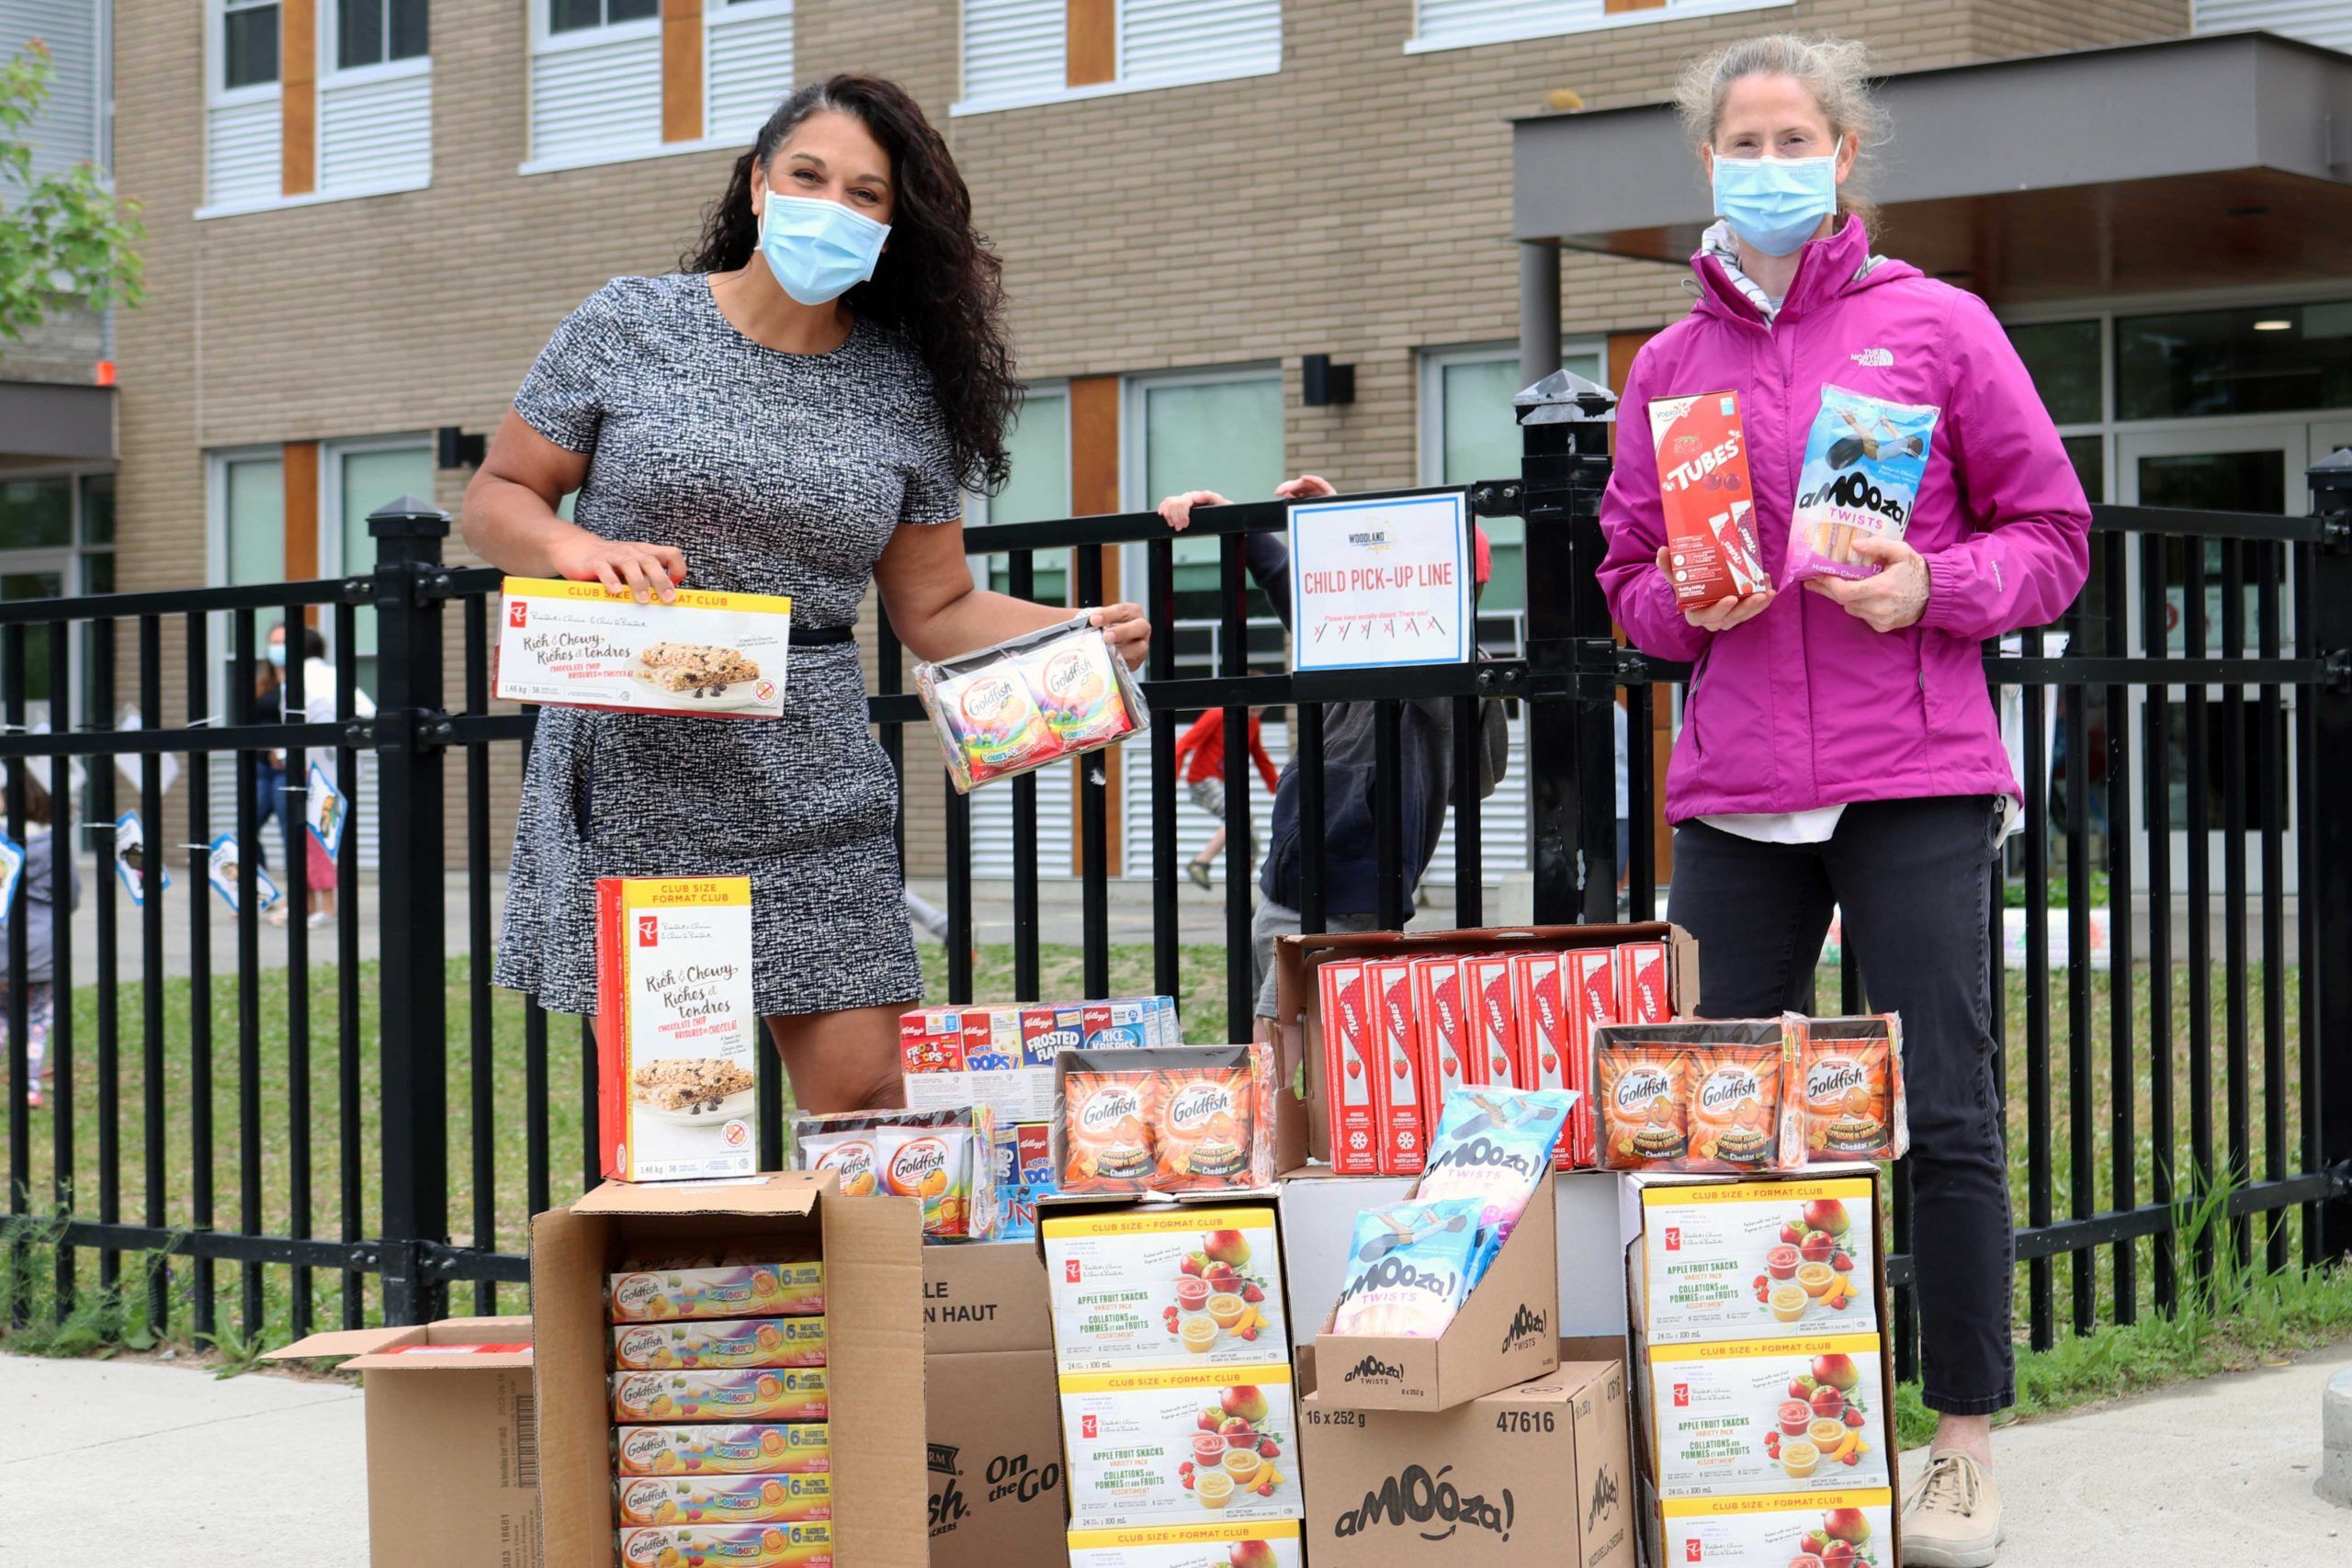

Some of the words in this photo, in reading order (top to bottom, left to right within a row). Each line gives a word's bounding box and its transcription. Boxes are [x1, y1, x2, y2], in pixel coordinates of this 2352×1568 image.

[1850, 354, 1880, 362] NORTH
[1666, 438, 1739, 491] TUBES
[1829, 507, 1883, 530] TWISTS
[1349, 532, 1385, 544] WOODLAND
[1872, 564, 1883, 574] 12
[1304, 570, 1346, 594] CHILD
[1351, 565, 1414, 592] PICK-UP
[1419, 563, 1453, 587] LINE
[568, 586, 600, 597] CLUB
[604, 590, 631, 600] SIZE
[696, 596, 728, 606] CLUB
[524, 633, 548, 651] Rich
[559, 632, 605, 649] Chewy
[537, 647, 573, 665] Riches
[584, 644, 631, 659] tendres
[1050, 655, 1093, 693] Goldfish
[968, 681, 1013, 716] Goldfish
[662, 885, 689, 893] CLUB
[693, 884, 717, 892] SIZE
[652, 895, 697, 904] FORMAT
[701, 893, 729, 903] CLUB
[646, 969, 676, 993] Rich
[687, 964, 739, 981] Chewy
[663, 986, 705, 1010] Riches
[1641, 984, 1658, 1017] TUBES
[679, 999, 731, 1020] tendres
[1084, 1012, 1110, 1022] Kellogg's
[1439, 1000, 1455, 1034] TUBES
[1487, 999, 1506, 1032] TUBES
[1538, 996, 1555, 1029] TUBES
[693, 1016, 707, 1026] CHIP
[1023, 1018, 1054, 1029] Kellogg's
[1343, 1002, 1360, 1036] TUBES
[1389, 1002, 1406, 1036] TUBES
[901, 1026, 925, 1036] Kellogg's
[963, 1027, 989, 1037] Kellogg's
[1102, 1031, 1125, 1042] RICE
[970, 1045, 992, 1055] CORN
[1027, 1031, 1080, 1054] FROSTED
[1808, 1067, 1863, 1098] Goldfish
[1618, 1078, 1668, 1108] Goldfish
[1703, 1080, 1757, 1109] Goldfish
[1084, 1098, 1137, 1126] Goldfish
[1174, 1092, 1228, 1122] Goldfish
[1020, 1139, 1046, 1149] Kellogg's
[1840, 1142, 1868, 1151] Cheddar
[1645, 1150, 1670, 1158] Cheddar
[1729, 1153, 1755, 1162] Cheddar
[896, 1151, 944, 1178] Goldfish
[1202, 1167, 1228, 1176] Cheddar
[1110, 1168, 1136, 1178] Cheddar
[1447, 1168, 1501, 1180] TWISTS
[1692, 1190, 1719, 1201] CLUB
[1721, 1190, 1744, 1199] SIZE
[1754, 1189, 1795, 1198] FORMAT
[1798, 1187, 1824, 1196] CLUB
[1091, 1223, 1118, 1232] CLUB
[1121, 1222, 1143, 1231] SIZE
[1154, 1220, 1193, 1229] FORMAT
[1197, 1218, 1224, 1227] CLUB
[1668, 1264, 1689, 1275] APPLE
[1689, 1262, 1710, 1273] FRUIT
[1711, 1260, 1739, 1271] SNACKS
[782, 1269, 793, 1286] 6
[619, 1282, 659, 1303] Goldfish
[1678, 1282, 1719, 1295] COLLATIONS
[1078, 1295, 1098, 1305] APPLE
[1099, 1293, 1119, 1303] FRUIT
[1121, 1292, 1148, 1302] SNACKS
[1362, 1292, 1419, 1305] TWISTS
[1669, 1292, 1700, 1304] POMMES
[1715, 1290, 1739, 1301] FRUITS
[943, 1304, 998, 1323] HAUT
[1088, 1314, 1129, 1325] COLLATIONS
[786, 1324, 797, 1340] 6
[1080, 1323, 1109, 1334] POMMES
[1125, 1321, 1149, 1330] FRUITS
[624, 1337, 663, 1357] Goldfish
[1514, 1337, 1536, 1352] TWISTS
[1700, 1347, 1726, 1356] CLUB
[1729, 1347, 1751, 1355] SIZE
[1762, 1343, 1803, 1353] FORMAT
[1805, 1342, 1831, 1351] CLUB
[786, 1374, 797, 1391] 6
[1109, 1378, 1136, 1387] CLUB
[1137, 1377, 1160, 1386] SIZE
[1170, 1375, 1211, 1384] FORMAT
[1215, 1374, 1241, 1382] CLUB
[624, 1382, 663, 1404] Goldfish
[1306, 1411, 1321, 1425] 16
[1323, 1415, 1331, 1425] x
[1333, 1411, 1356, 1426] 252
[1358, 1415, 1366, 1428] g
[1496, 1411, 1555, 1433] 47616
[1678, 1421, 1700, 1431] APPLE
[1700, 1419, 1721, 1429] FRUIT
[1722, 1416, 1750, 1427] SNACKS
[790, 1429, 799, 1446] 6
[1689, 1438, 1731, 1451] COLLATIONS
[628, 1438, 667, 1458] Goldfish
[1093, 1451, 1114, 1461] APPLE
[1115, 1450, 1135, 1460] FRUIT
[1136, 1447, 1164, 1457] SNACKS
[1680, 1449, 1711, 1461] POMMES
[1725, 1446, 1750, 1457] FRUITS
[985, 1454, 1029, 1484] On
[1103, 1469, 1145, 1481] COLLATIONS
[790, 1479, 801, 1495] 6
[1095, 1479, 1125, 1491] POMMES
[1140, 1476, 1165, 1486] FRUITS
[989, 1481, 1018, 1502] the
[628, 1490, 669, 1509] Goldfish
[1713, 1503, 1738, 1511] CLUB
[1741, 1501, 1764, 1510] SIZE
[1774, 1499, 1815, 1507] FORMAT
[1818, 1497, 1844, 1506] CLUB
[790, 1527, 801, 1542] 6
[1117, 1534, 1144, 1543] CLUB
[1147, 1532, 1170, 1541] SIZE
[1179, 1530, 1220, 1540] FORMAT
[1223, 1529, 1250, 1538] CLUB
[630, 1538, 669, 1558] Goldfish
